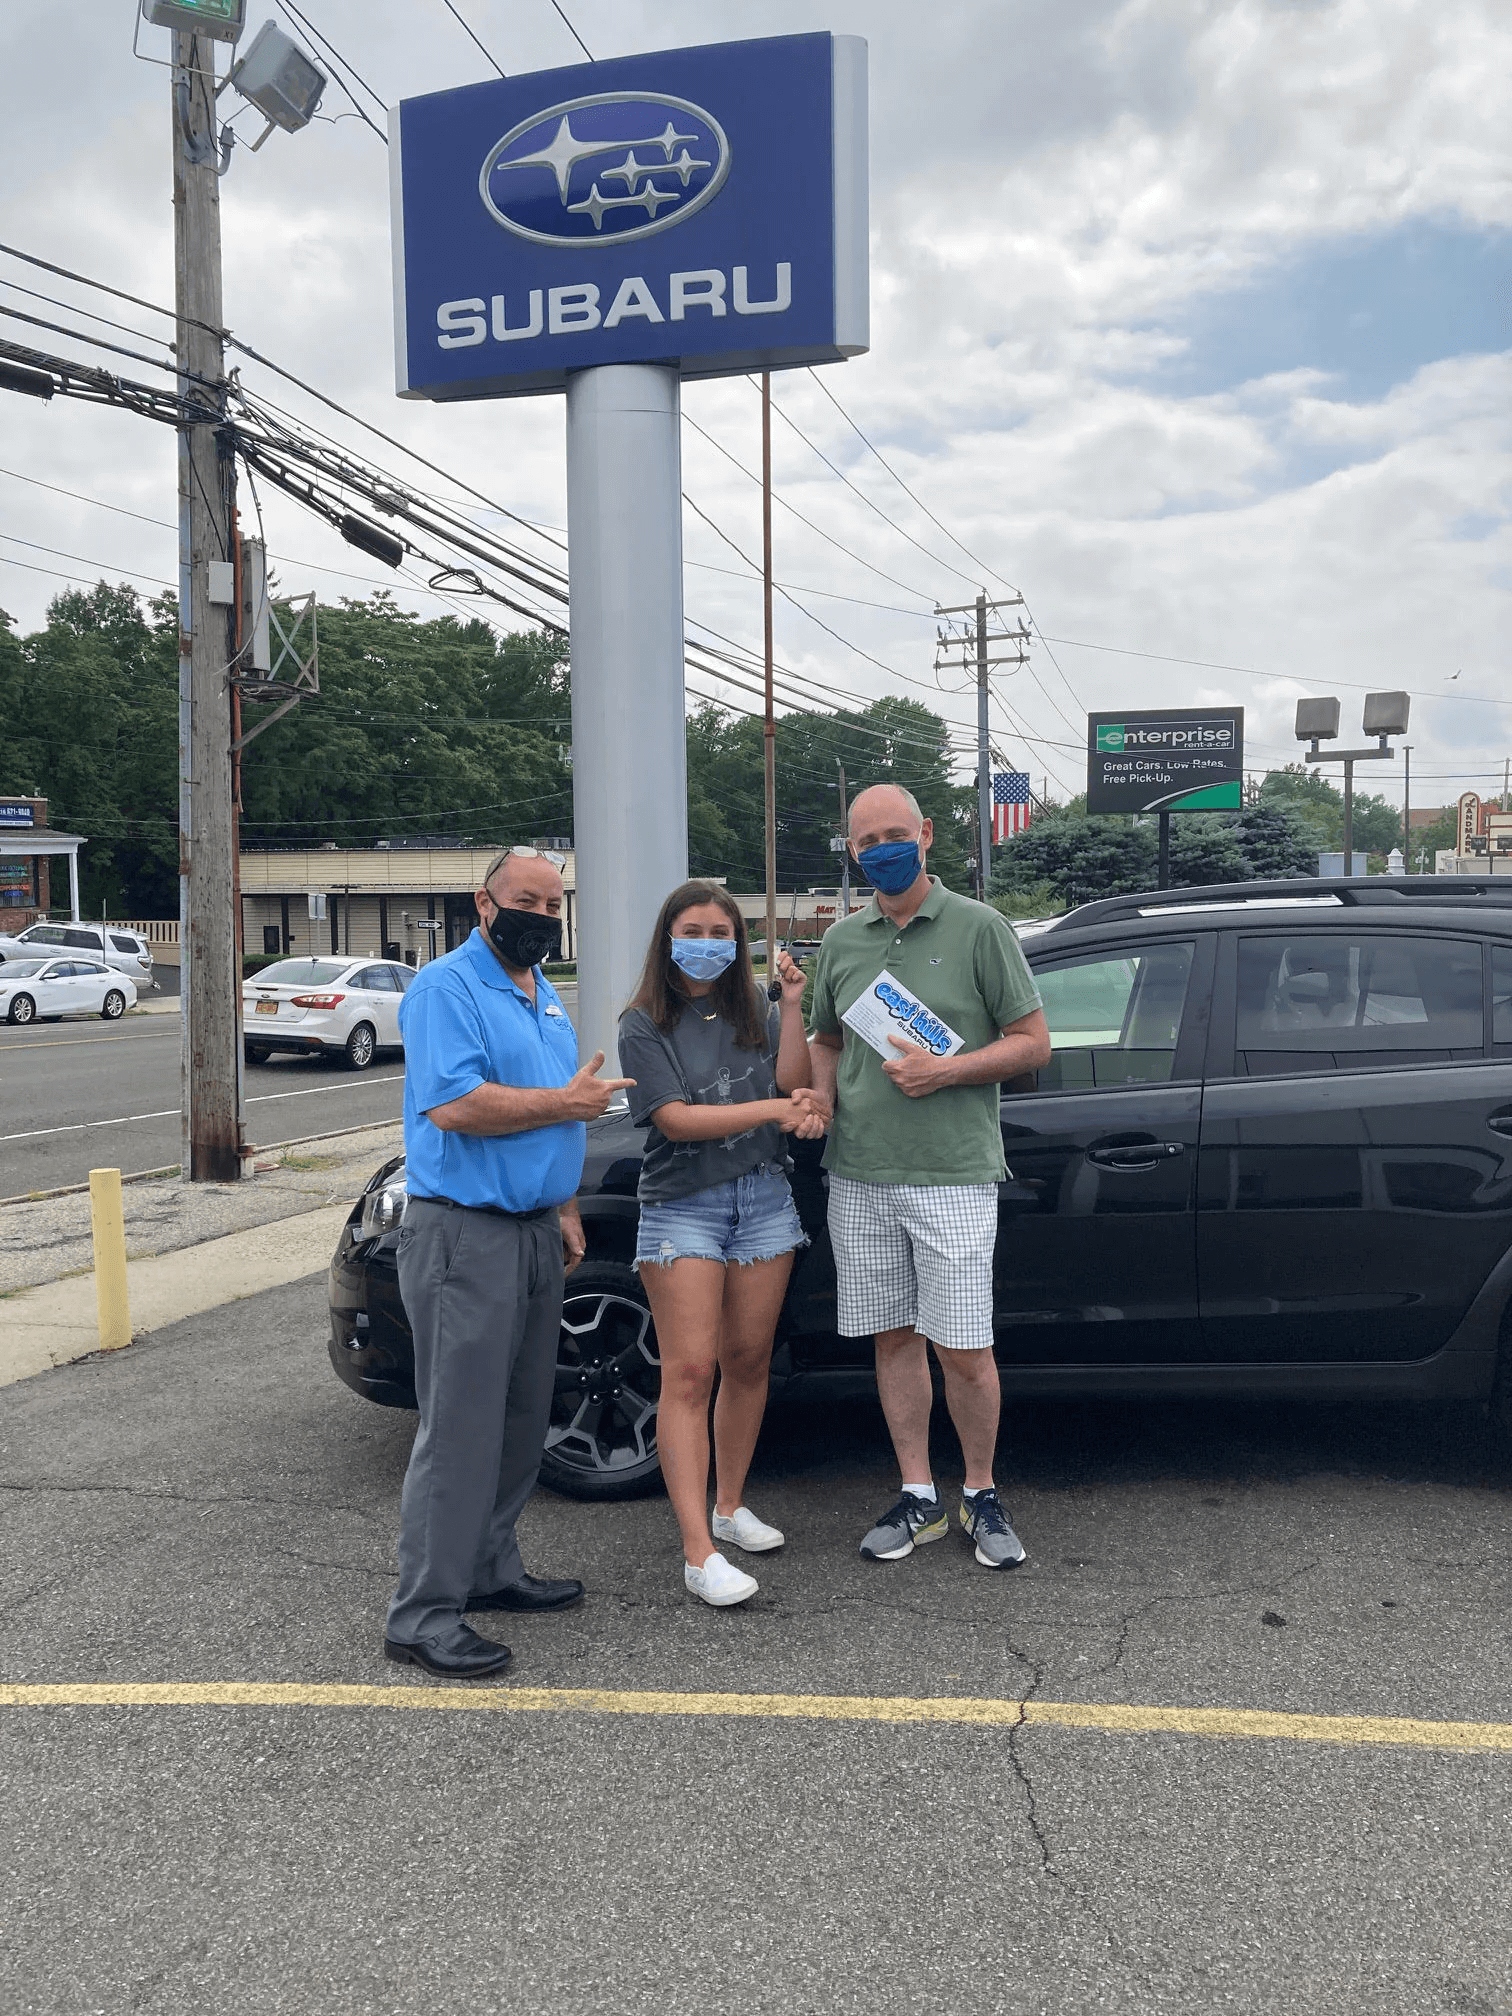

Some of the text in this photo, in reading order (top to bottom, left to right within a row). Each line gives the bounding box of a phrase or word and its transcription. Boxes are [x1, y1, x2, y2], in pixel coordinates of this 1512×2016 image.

[436, 262, 792, 350] SUBARU
[1104, 727, 1231, 746] enterprise
[1103, 760, 1227, 772] Great Cars. Low Rates.
[1103, 773, 1174, 784] Free Pick-Up.
[1464, 797, 1475, 854] LANDMARK
[874, 982, 920, 1022] east
[909, 1010, 953, 1056] hills
[896, 1021, 928, 1049] SUBARU
